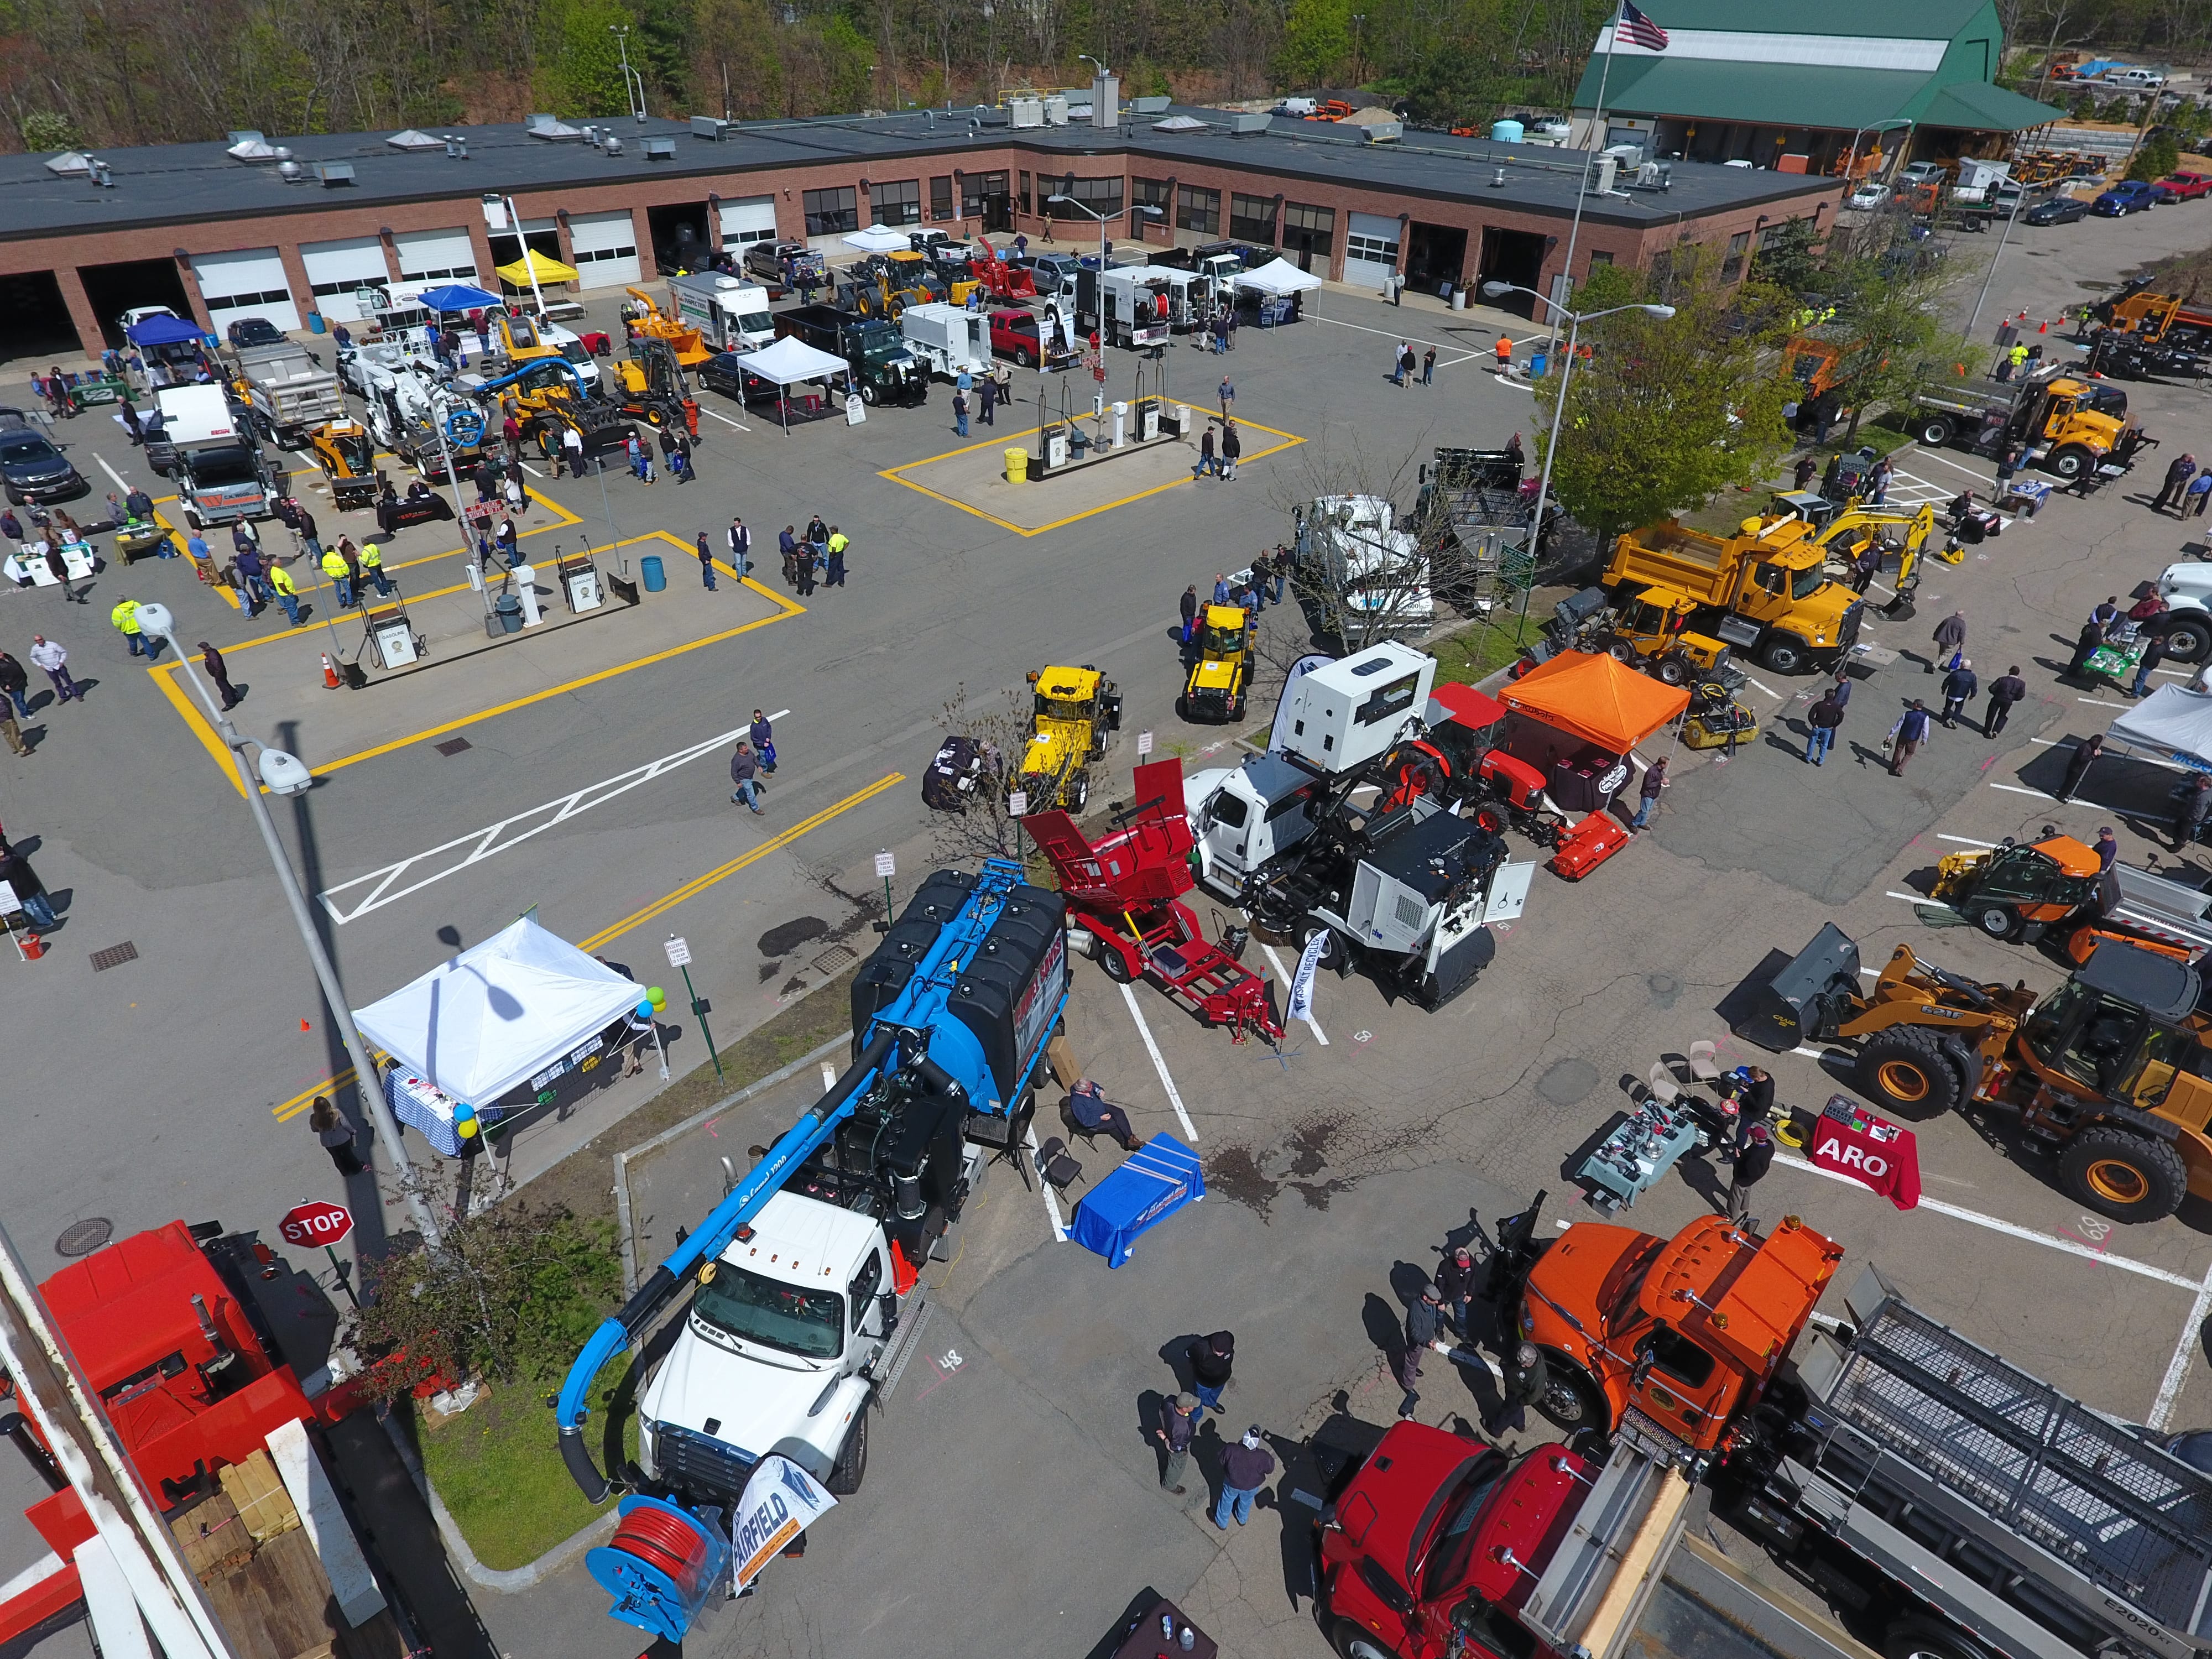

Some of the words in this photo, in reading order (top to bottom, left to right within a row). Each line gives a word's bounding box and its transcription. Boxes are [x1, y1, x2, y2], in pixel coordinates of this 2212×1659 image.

[382, 630, 405, 640] GASOLINE
[2167, 750, 2212, 775] McDe
[1497, 921, 1511, 931] 51
[1040, 935, 1062, 983] SAVES
[1297, 972, 1311, 999] ASPHALT
[1304, 937, 1321, 972] RECYCLER
[1773, 1015, 1796, 1026] CRAIG
[1921, 1005, 1965, 1020] 621F
[1354, 1030, 1372, 1042] 50
[1817, 1136, 1887, 1177] ARO
[750, 1171, 770, 1197] Camel
[285, 1211, 344, 1239] STOP
[1496, 1244, 1505, 1252] 59
[938, 1349, 962, 1371] 48
[733, 1491, 789, 1571] FAIRFIELD
